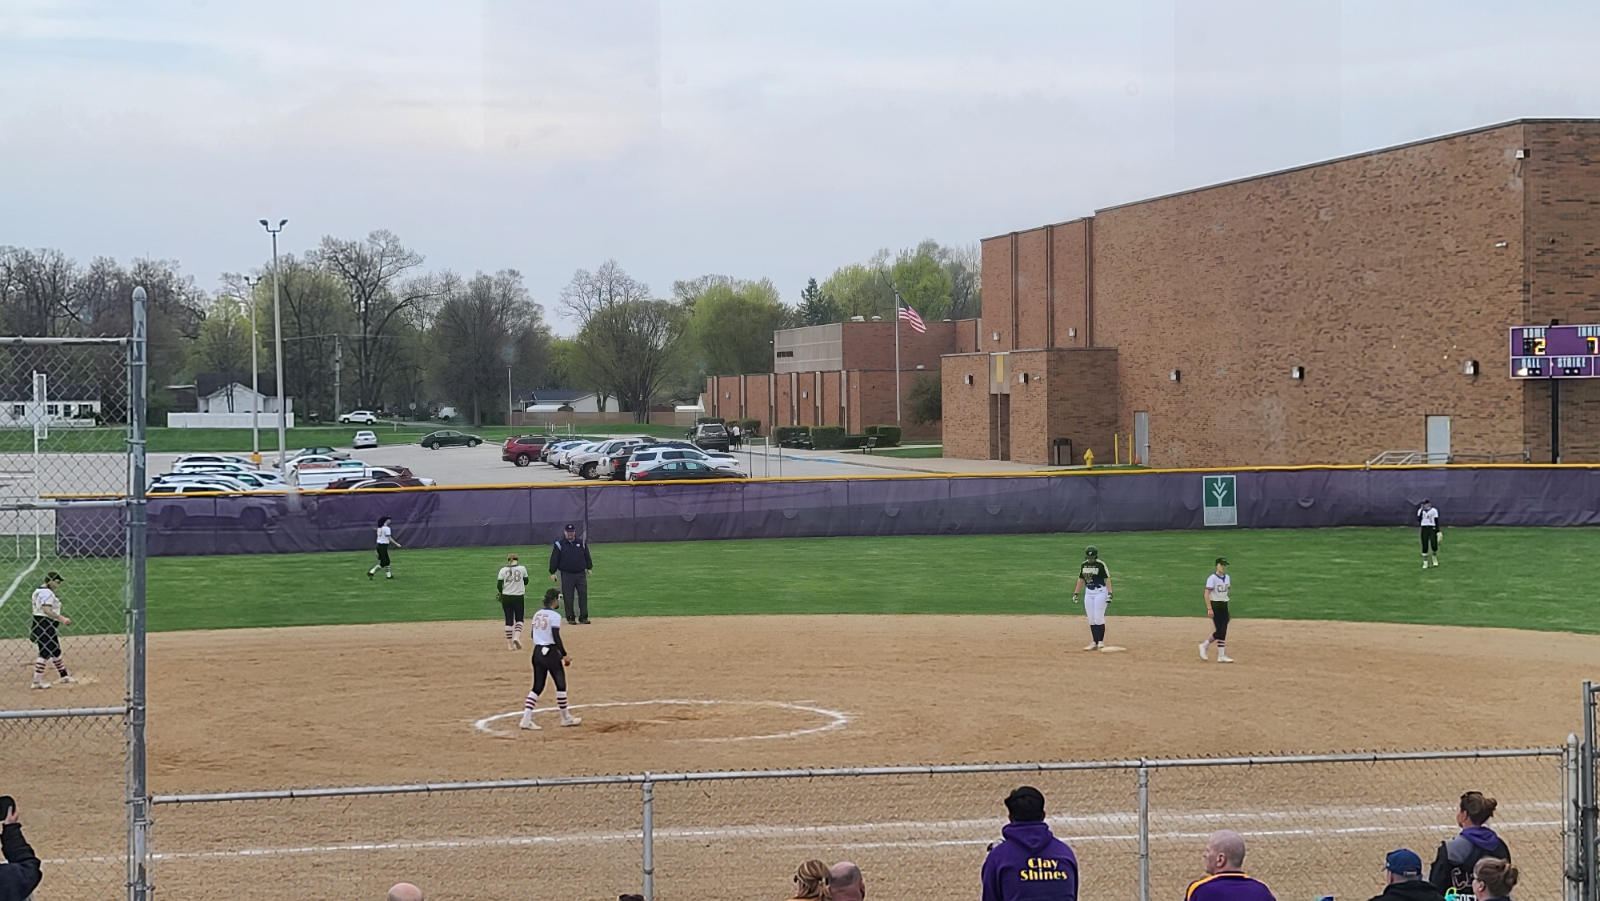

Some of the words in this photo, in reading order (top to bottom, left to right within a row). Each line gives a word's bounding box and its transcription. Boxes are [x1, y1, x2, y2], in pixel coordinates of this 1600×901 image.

[1534, 338, 1546, 355] 2
[1587, 336, 1599, 354] 7
[505, 569, 522, 583] 28
[533, 613, 549, 630] 55
[1027, 857, 1059, 870] Clay
[1020, 869, 1068, 881] Shines
